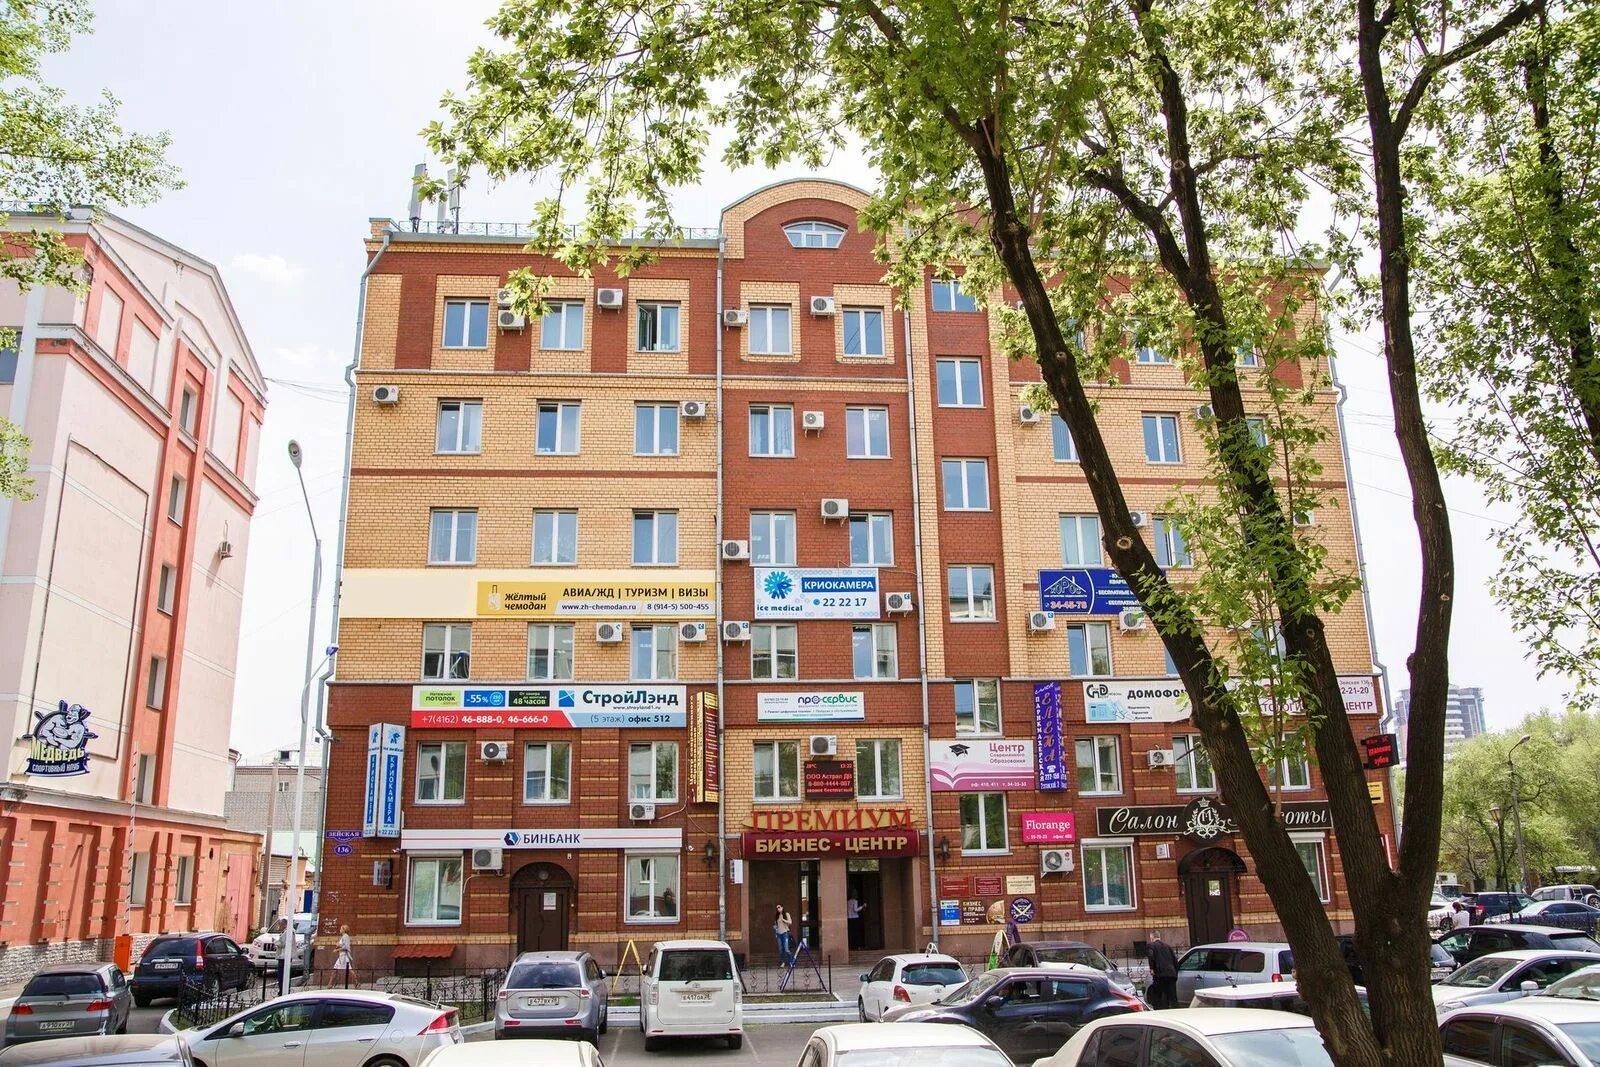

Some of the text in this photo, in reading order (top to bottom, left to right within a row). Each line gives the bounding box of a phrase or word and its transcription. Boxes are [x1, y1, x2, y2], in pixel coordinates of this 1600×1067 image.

[804, 581, 874, 590] КРИОКАМЕРА
[504, 592, 546, 601] Жёлтый
[563, 588, 708, 598] АВИА/ЖД ТУРИЗМ ВИЗЫ
[504, 602, 546, 611] чемодан
[823, 598, 867, 607] 22 22 17
[582, 690, 678, 707] СтройЛэнд
[1127, 689, 1184, 700] ДОМОФО
[422, 715, 458, 724] +7(4162)
[590, 715, 599, 723] (5
[602, 715, 625, 723] этаж)
[628, 715, 651, 724] офис
[1036, 696, 1044, 781] ПАРИКМАХЕРСКАЯ
[31, 737, 84, 763] МЕДВЕДЬ
[989, 742, 1024, 753] Центр
[386, 756, 395, 823] КРИОКАМЕРА
[751, 808, 912, 832] ПРЕМИУМ
[1109, 807, 1178, 834] Салон
[1026, 820, 1070, 832] Florange
[523, 833, 581, 844] БИНБАНК
[756, 837, 830, 852] БИЗНЕС
[845, 837, 908, 853] ЦЕНТР
